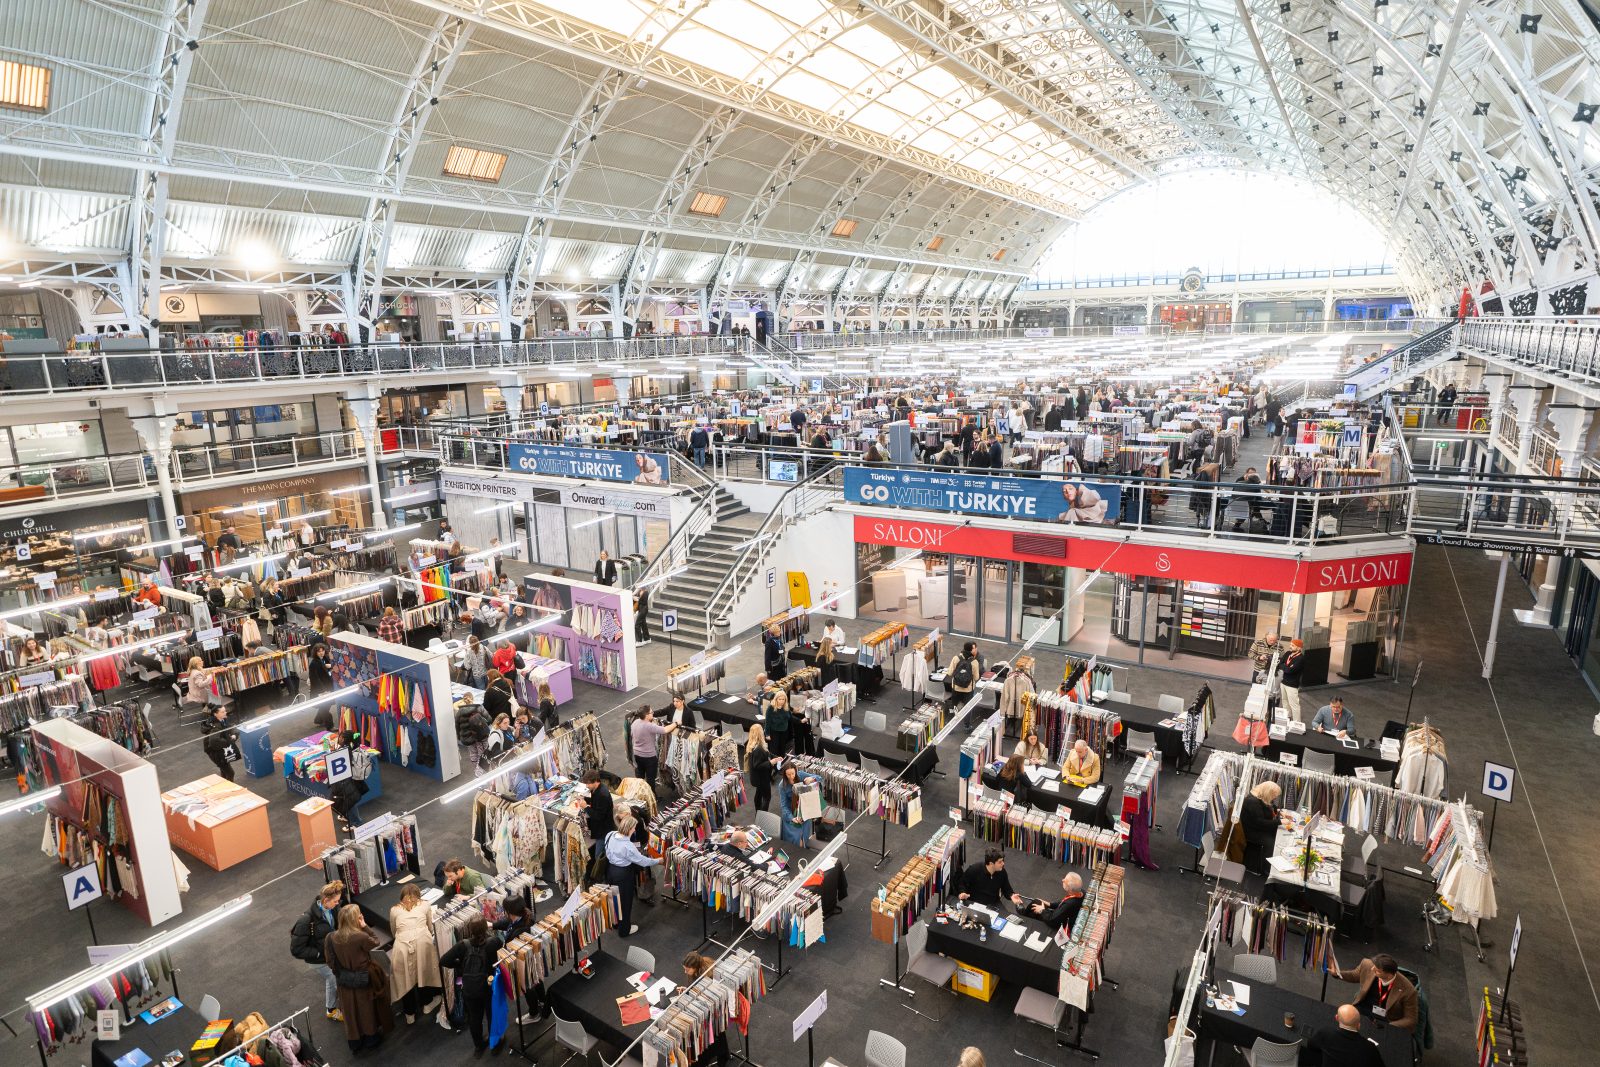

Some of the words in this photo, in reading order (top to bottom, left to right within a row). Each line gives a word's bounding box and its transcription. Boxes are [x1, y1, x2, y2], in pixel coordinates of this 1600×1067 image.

[542, 404, 548, 412] G
[999, 421, 1008, 431] K
[1125, 427, 1130, 436] L
[1345, 430, 1359, 443] M
[519, 456, 537, 470] GO
[538, 458, 569, 474] WITH
[242, 486, 257, 494] THE
[257, 483, 278, 492] MAIN
[279, 477, 316, 489] COMPANY
[870, 473, 896, 482] Türkiye
[444, 480, 481, 492] EXHIBITION
[482, 484, 517, 496] PRINTERS
[860, 484, 889, 502] GO
[892, 486, 943, 507] WITH
[176, 518, 184, 527] D
[873, 523, 942, 546] SALONI
[18, 548, 28, 557] C
[1463, 539, 1482, 548] Floor
[1483, 541, 1524, 552] Showrooms
[1535, 546, 1557, 555] Toilets
[768, 572, 774, 584] E
[1320, 560, 1398, 587] SALONI
[665, 614, 675, 627] D
[331, 756, 348, 777] B
[1488, 770, 1508, 792] D
[73, 875, 95, 901] A
